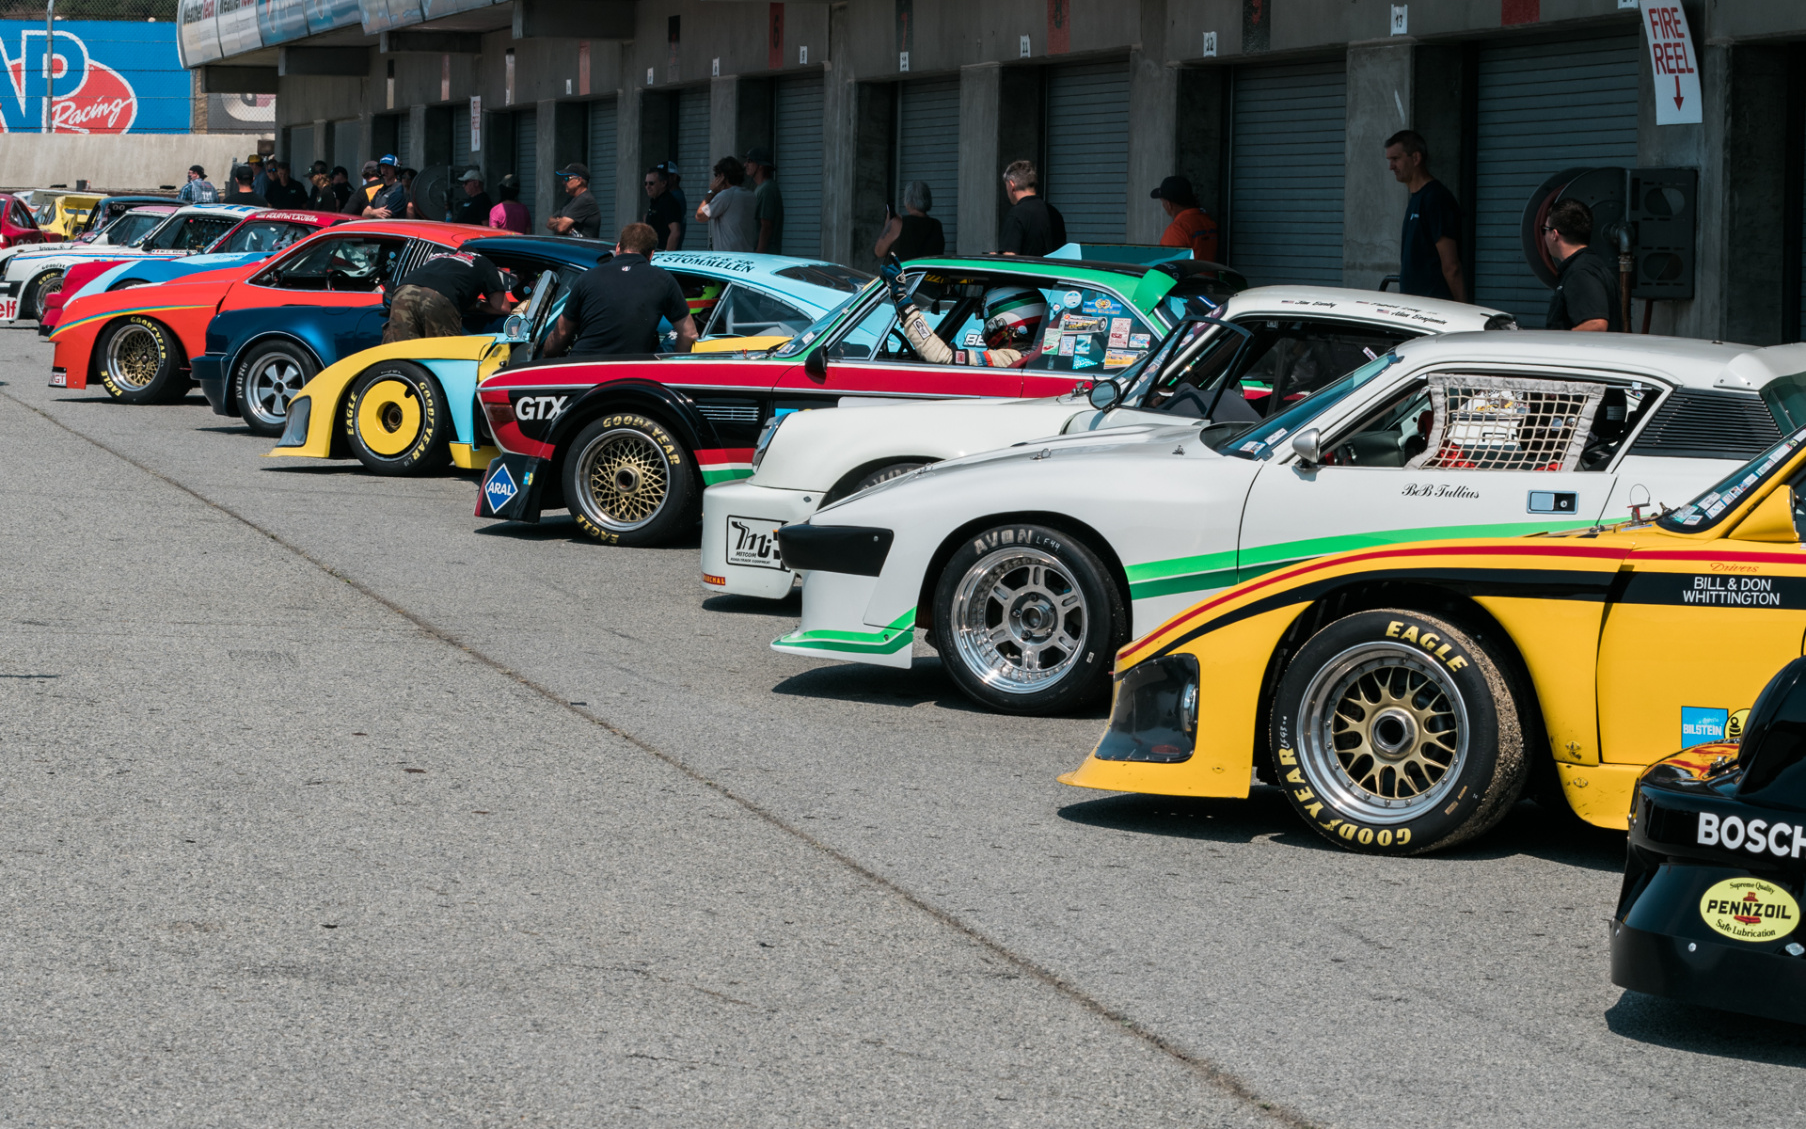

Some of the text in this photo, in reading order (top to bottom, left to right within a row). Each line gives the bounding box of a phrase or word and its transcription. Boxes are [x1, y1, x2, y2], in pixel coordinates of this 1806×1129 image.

[1648, 6, 1685, 40] FIRE
[1652, 41, 1695, 75] REEL
[52, 95, 131, 133] Racing
[265, 211, 291, 221] MARTIN
[663, 256, 756, 274] STOMMELEN
[100, 370, 123, 397] EAGLE
[345, 391, 358, 436] EAGLE
[515, 395, 570, 422] GTX
[487, 481, 513, 497] ARAL
[1434, 483, 1480, 500] Tullius
[576, 513, 619, 545] EAGLE
[973, 528, 1033, 556] AVON
[735, 551, 757, 560] MITCOM
[1710, 562, 1760, 573] Drivers
[1693, 576, 1772, 592] BILL & DON
[1682, 590, 1780, 606] WHITTINGTON
[1385, 620, 1469, 673] EAGLE
[1682, 723, 1723, 737] BILSTEIN
[1278, 747, 1412, 847] GOODYEAR
[1729, 881, 1775, 895] Supreme Quality
[1706, 899, 1792, 920] PENNZOIL
[1716, 918, 1776, 938] Safe Lubrication
